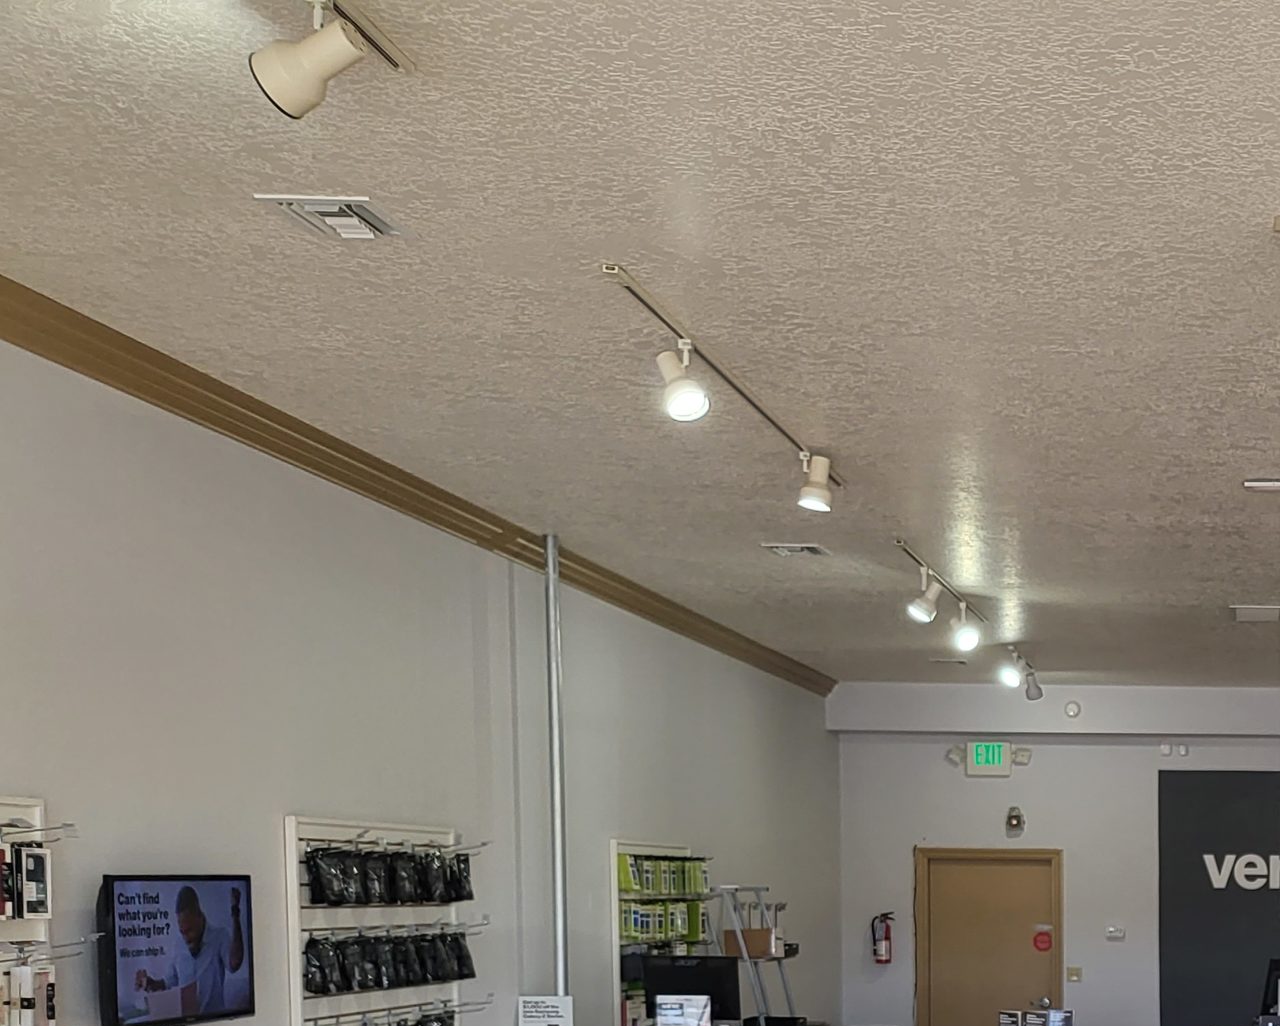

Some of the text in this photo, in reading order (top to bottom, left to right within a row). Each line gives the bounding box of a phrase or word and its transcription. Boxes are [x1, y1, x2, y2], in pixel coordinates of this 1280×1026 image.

[975, 744, 1004, 766] EXIT
[117, 892, 160, 906] Can't find
[118, 909, 169, 922] what you're
[119, 923, 170, 938] looking for?
